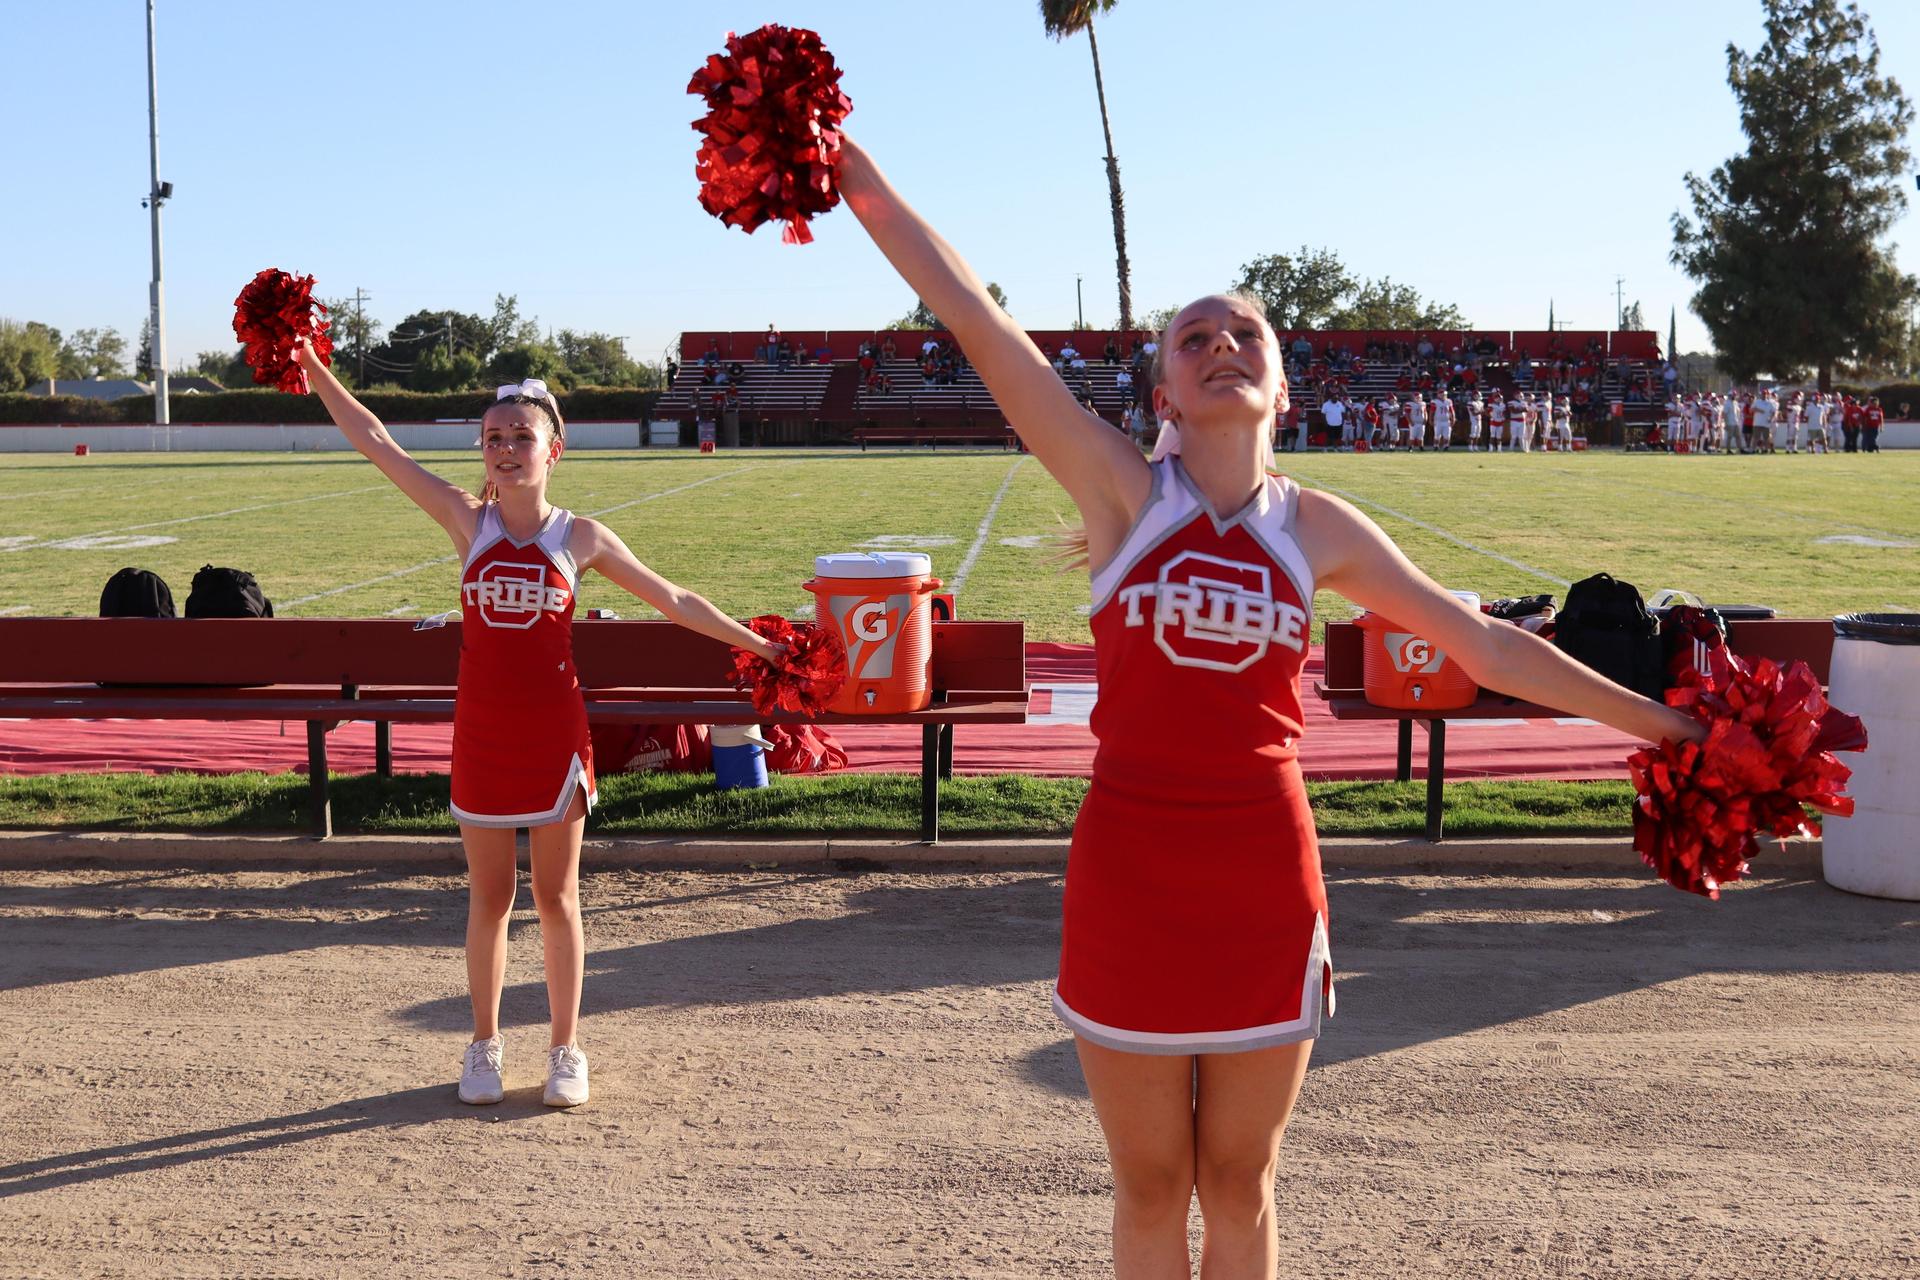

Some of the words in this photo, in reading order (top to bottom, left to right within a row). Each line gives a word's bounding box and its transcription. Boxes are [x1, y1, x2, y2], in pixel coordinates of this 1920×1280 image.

[700, 442, 714, 453] 40
[463, 580, 569, 613] TRIBE
[852, 601, 888, 642] G
[1118, 581, 1307, 654] TRIBE
[1405, 639, 1430, 665] G
